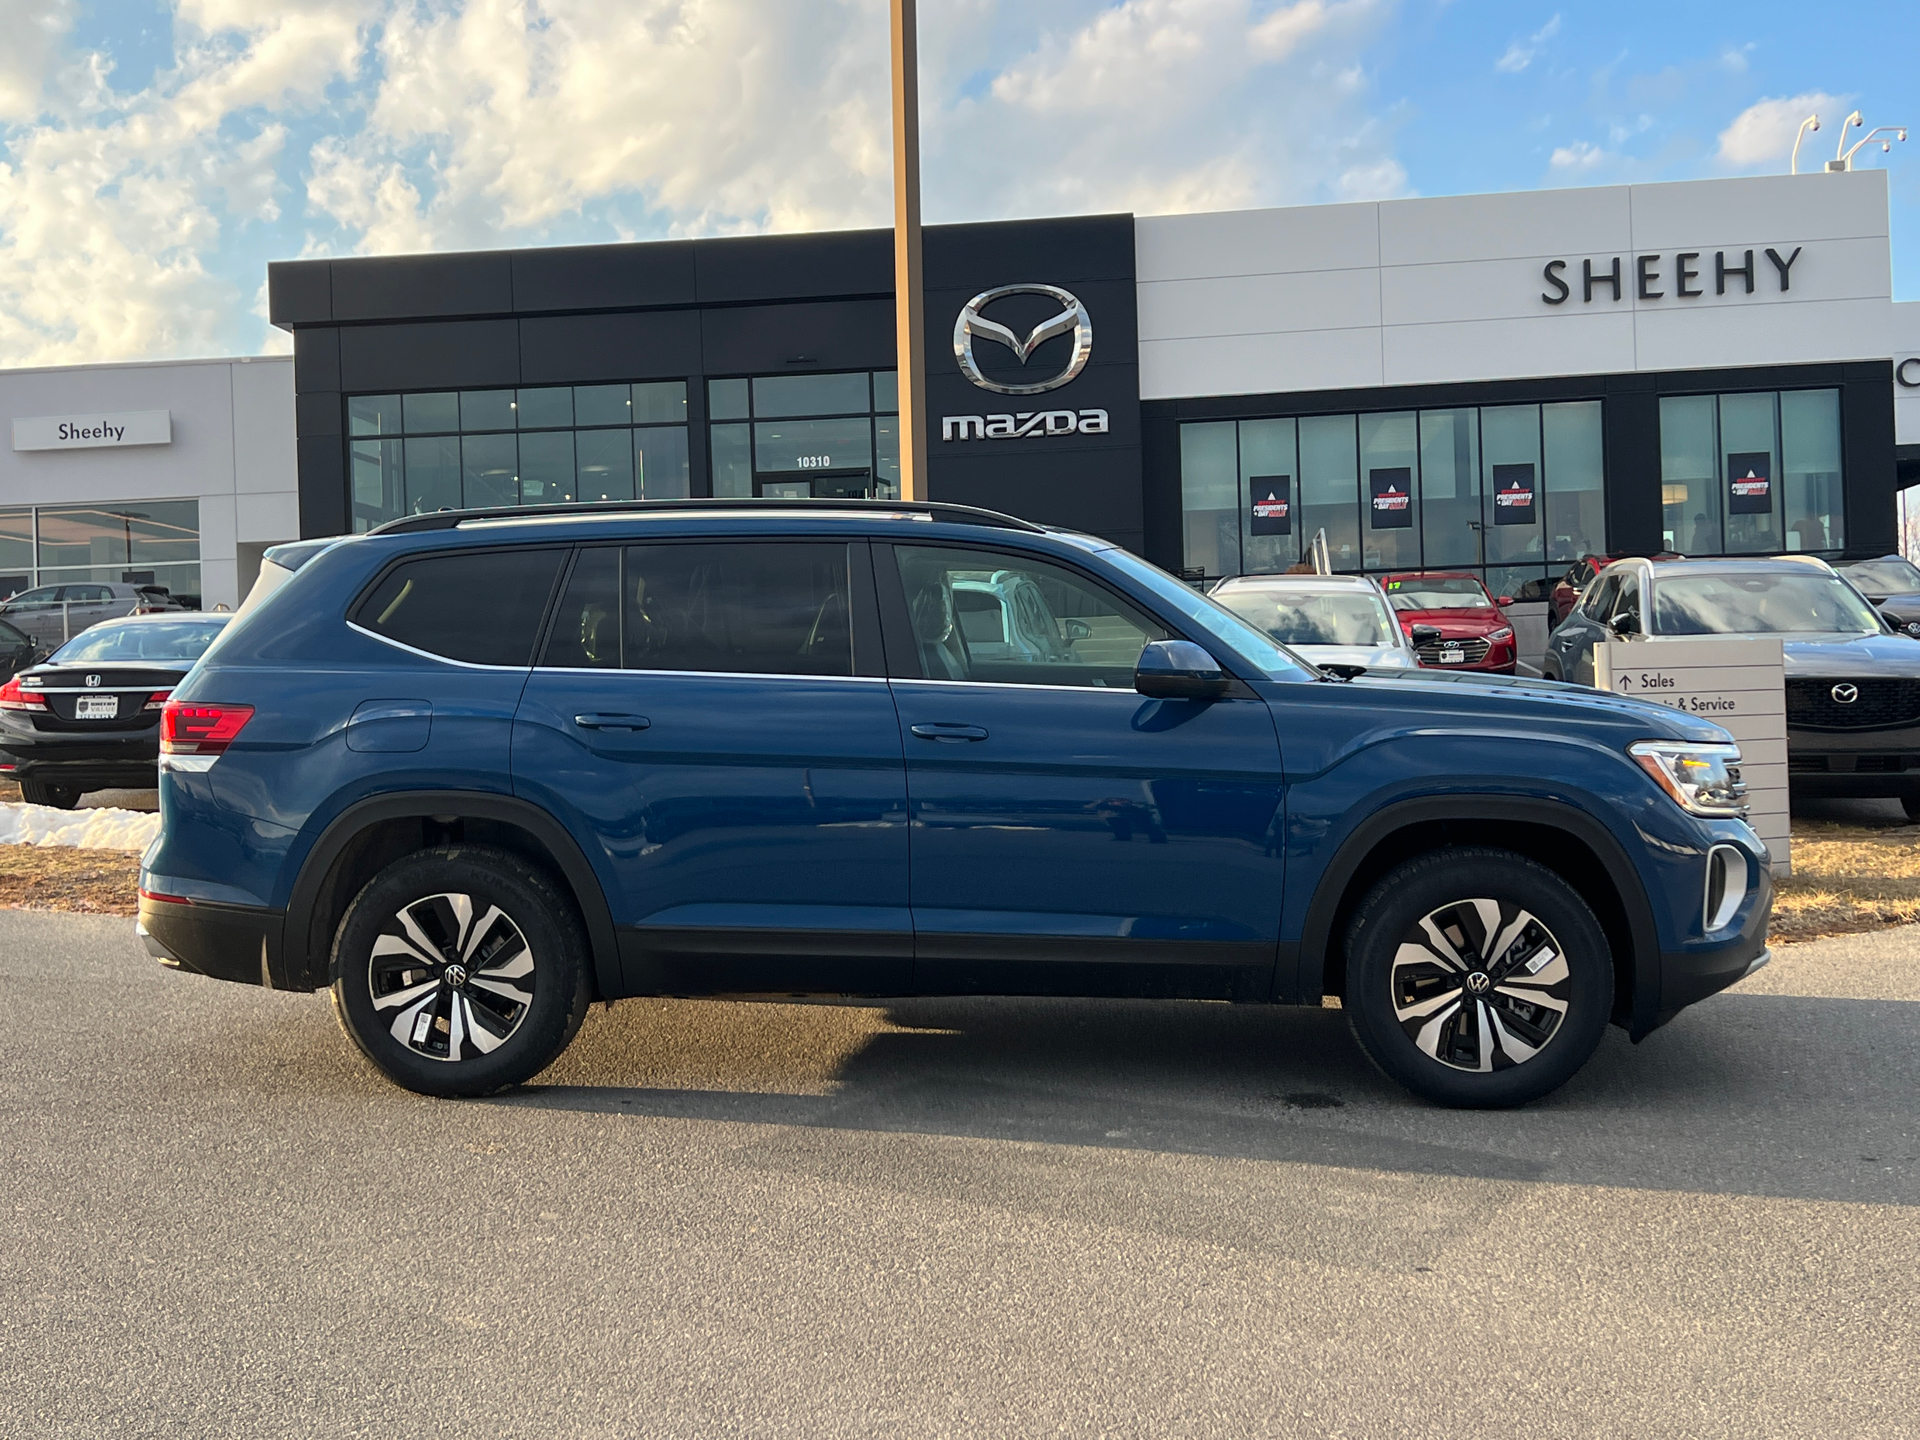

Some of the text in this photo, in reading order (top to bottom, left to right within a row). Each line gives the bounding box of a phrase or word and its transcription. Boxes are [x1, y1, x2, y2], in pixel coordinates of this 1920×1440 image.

[1541, 246, 1802, 306] SHEEHY
[58, 420, 125, 442] Sheehy
[796, 455, 831, 469] 10310
[1641, 672, 1675, 688] Sales
[1677, 697, 1687, 710] &
[1691, 696, 1735, 711] Service
